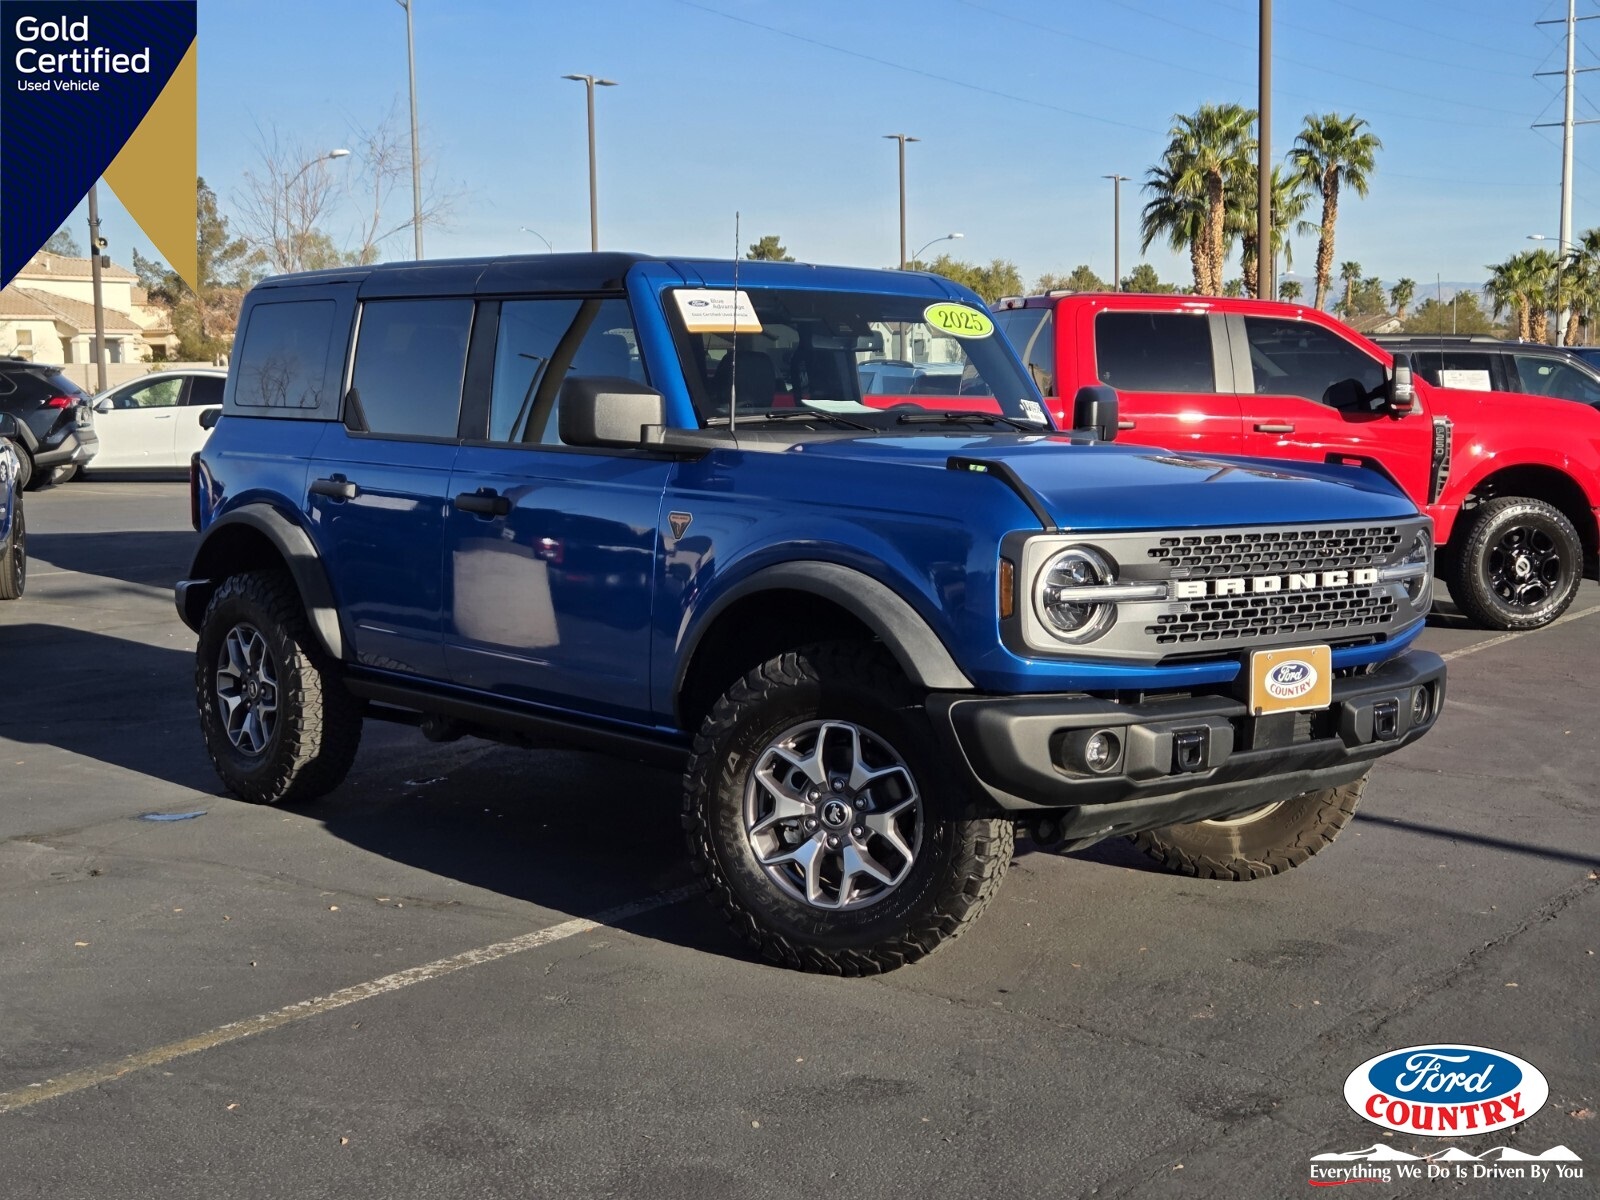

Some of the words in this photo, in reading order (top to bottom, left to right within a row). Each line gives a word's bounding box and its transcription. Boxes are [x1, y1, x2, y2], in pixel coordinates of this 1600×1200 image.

[713, 303, 745, 311] Advantge
[938, 310, 983, 332] 2025
[1176, 568, 1378, 598] BRONCO
[1277, 664, 1304, 682] Ford
[1270, 679, 1312, 696] COUNTRY
